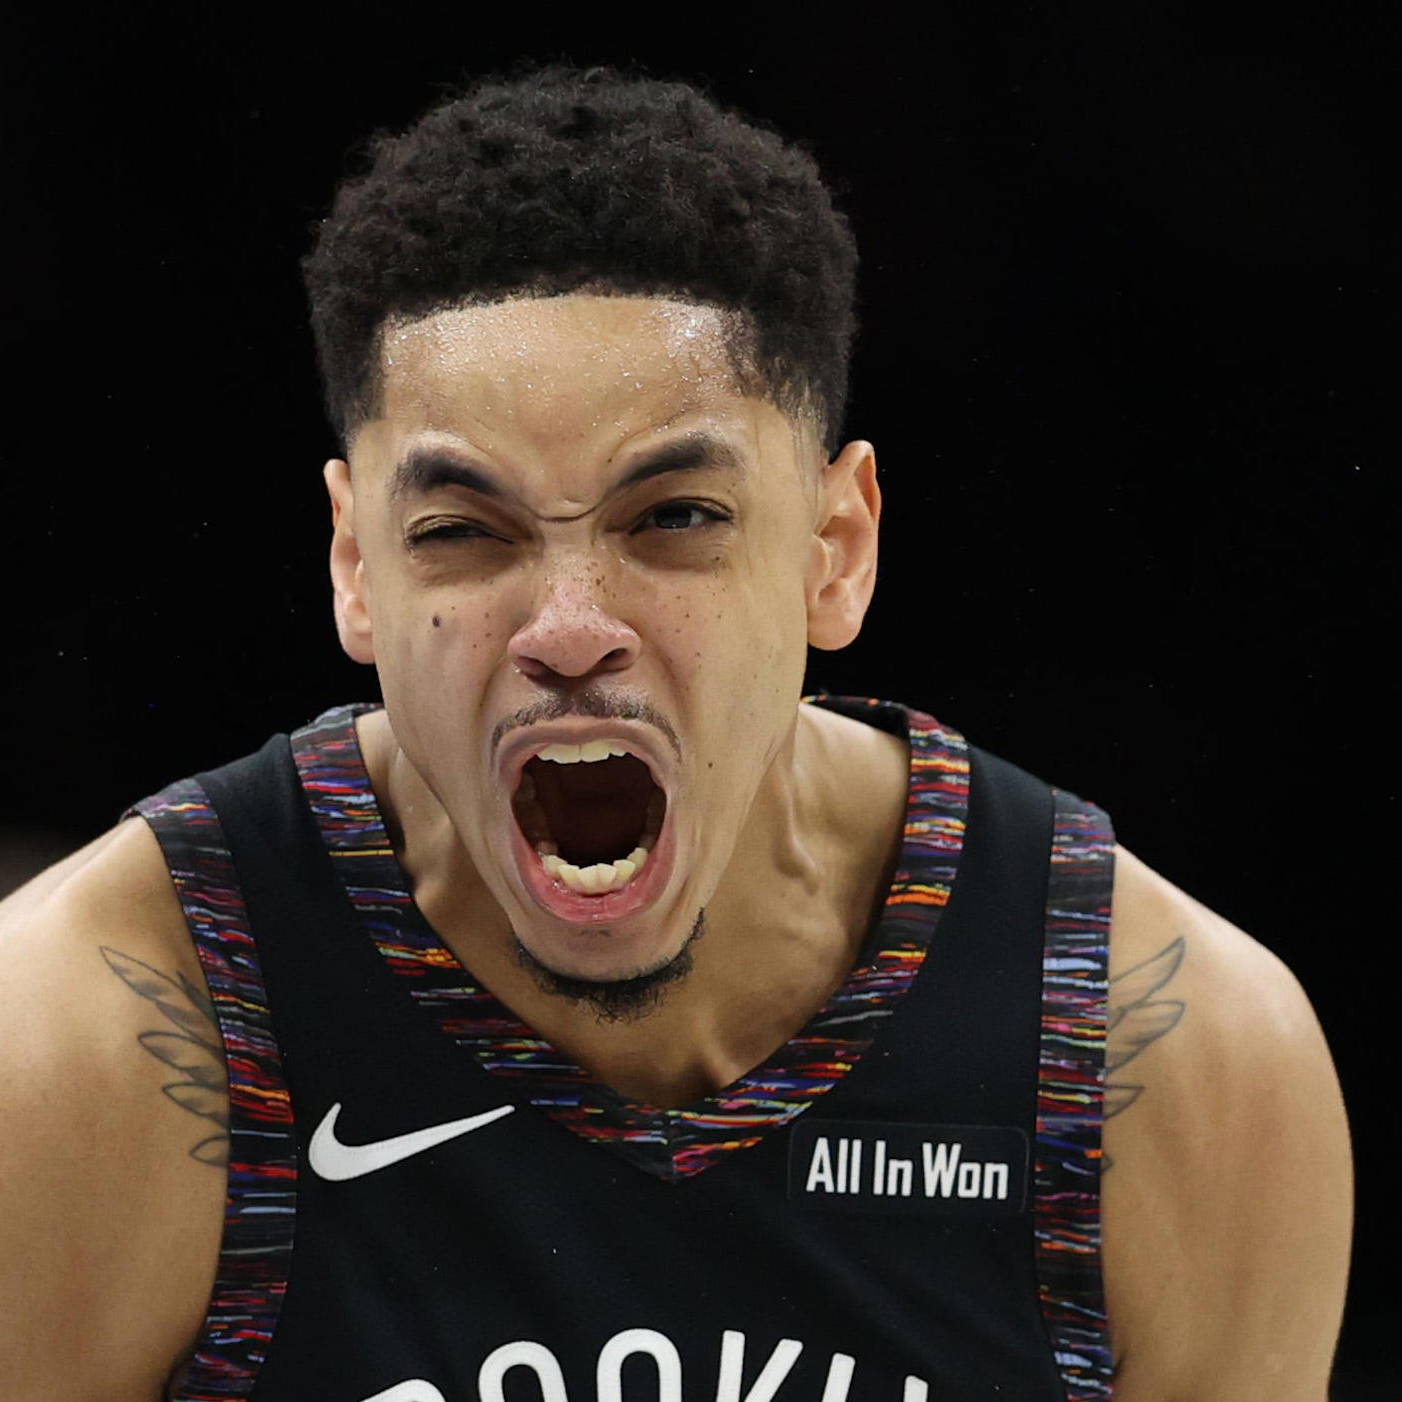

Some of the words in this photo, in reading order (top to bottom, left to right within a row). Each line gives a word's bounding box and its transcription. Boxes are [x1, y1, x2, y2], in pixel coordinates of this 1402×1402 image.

[806, 1137, 862, 1194] All
[873, 1140, 913, 1197] In
[922, 1142, 1009, 1200] Won
